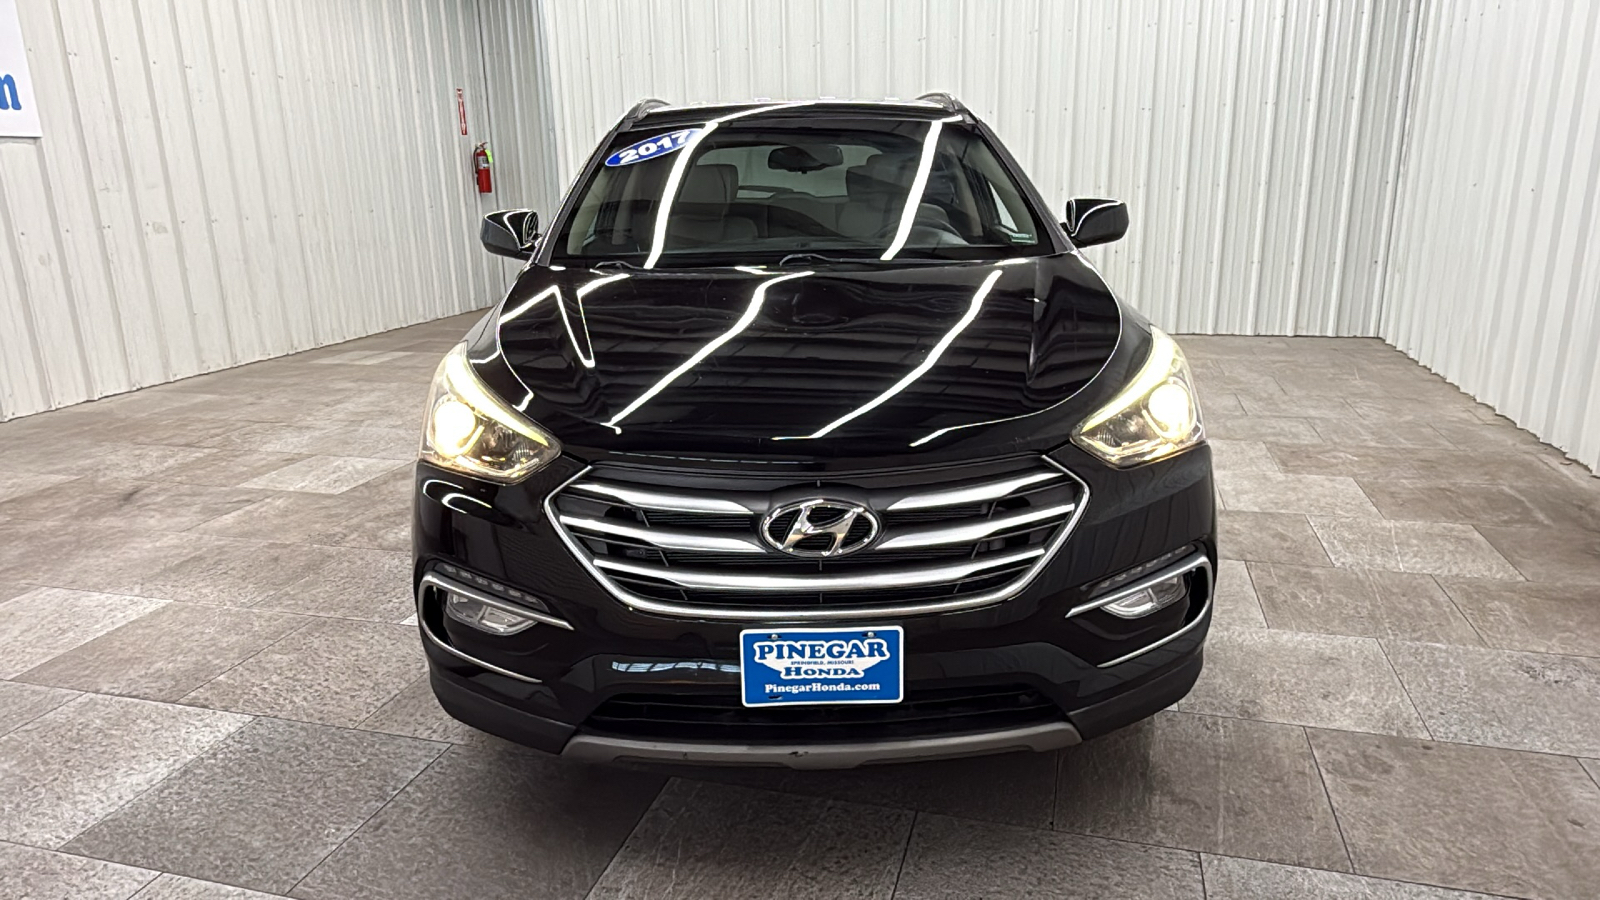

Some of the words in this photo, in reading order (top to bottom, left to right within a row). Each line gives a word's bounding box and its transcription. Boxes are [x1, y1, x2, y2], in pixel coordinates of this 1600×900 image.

[618, 130, 691, 164] 2017
[757, 641, 888, 660] PINEGAR
[784, 666, 861, 677] HONDA
[765, 682, 880, 694] PinegarHonda.com
